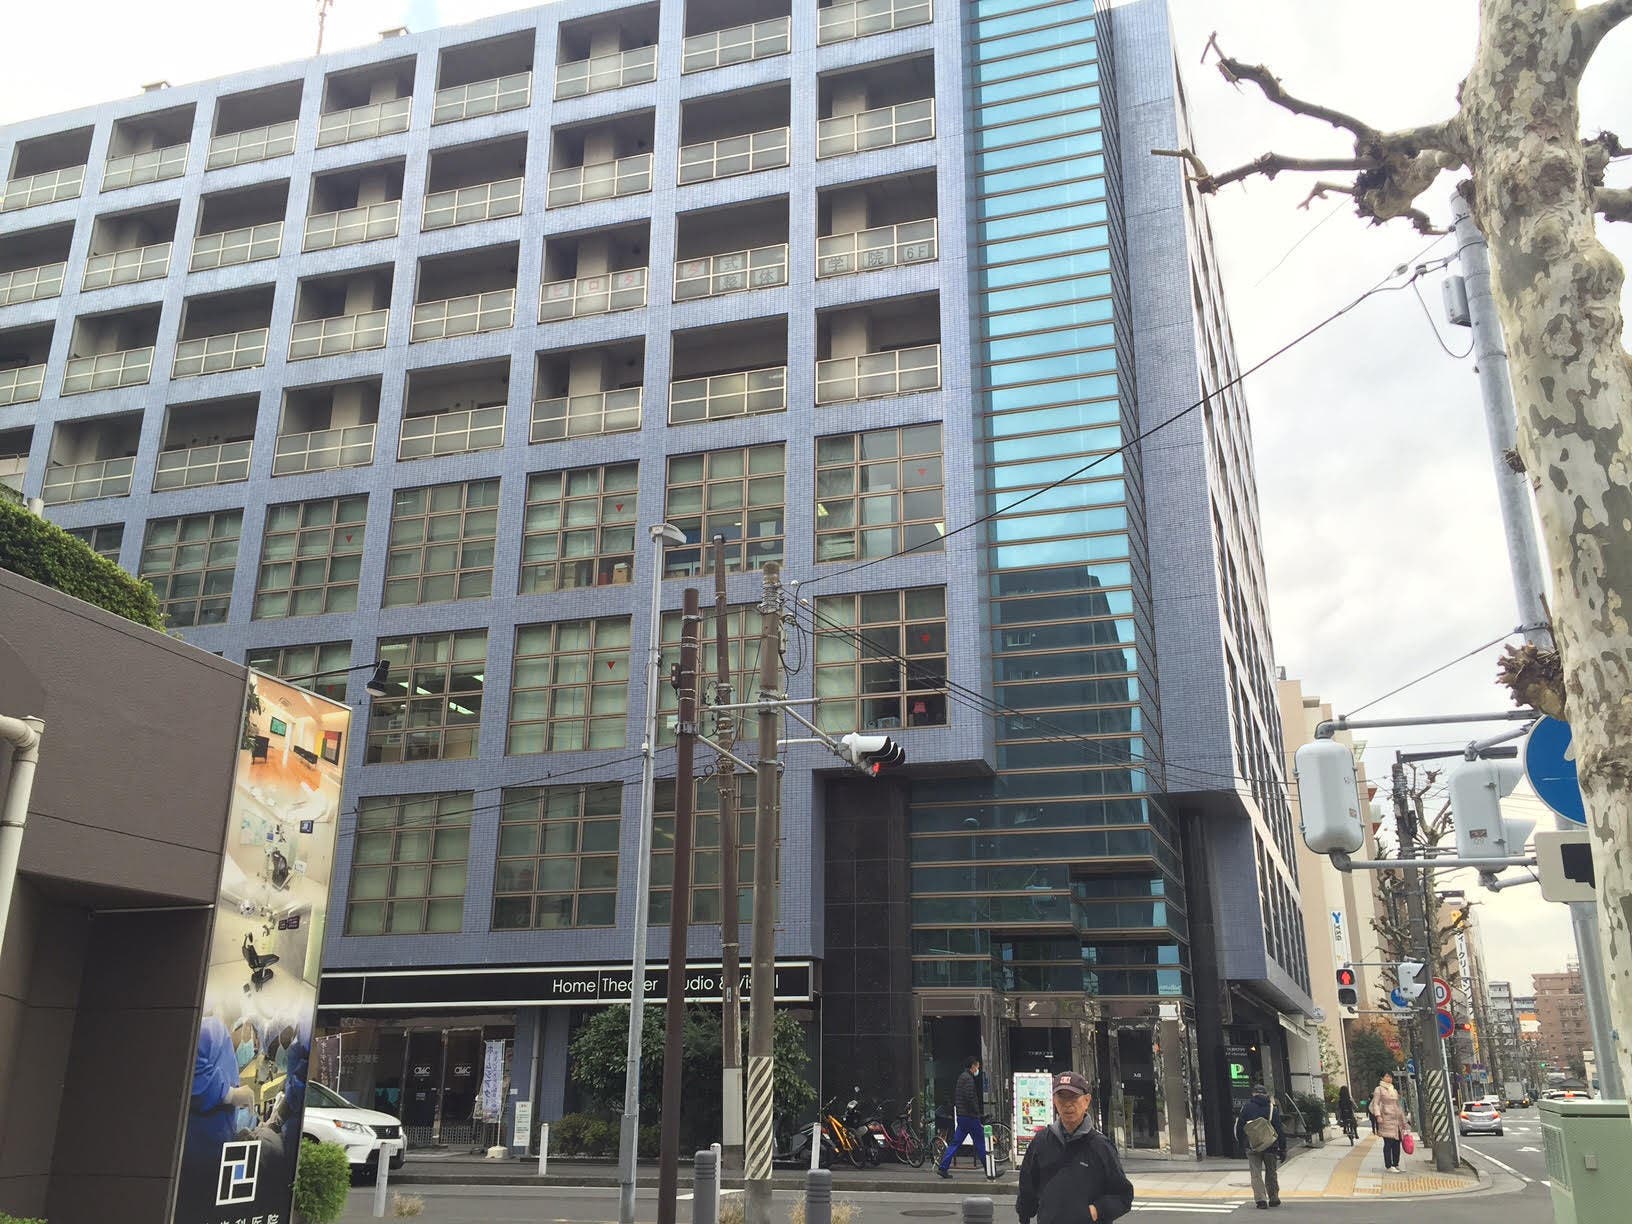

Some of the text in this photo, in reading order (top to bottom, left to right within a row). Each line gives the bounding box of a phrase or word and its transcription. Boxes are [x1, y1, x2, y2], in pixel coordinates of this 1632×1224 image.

[552, 978, 596, 993] Home
[602, 977, 659, 992] Theer
[684, 975, 714, 990] udio
[1435, 985, 1444, 999] 0
